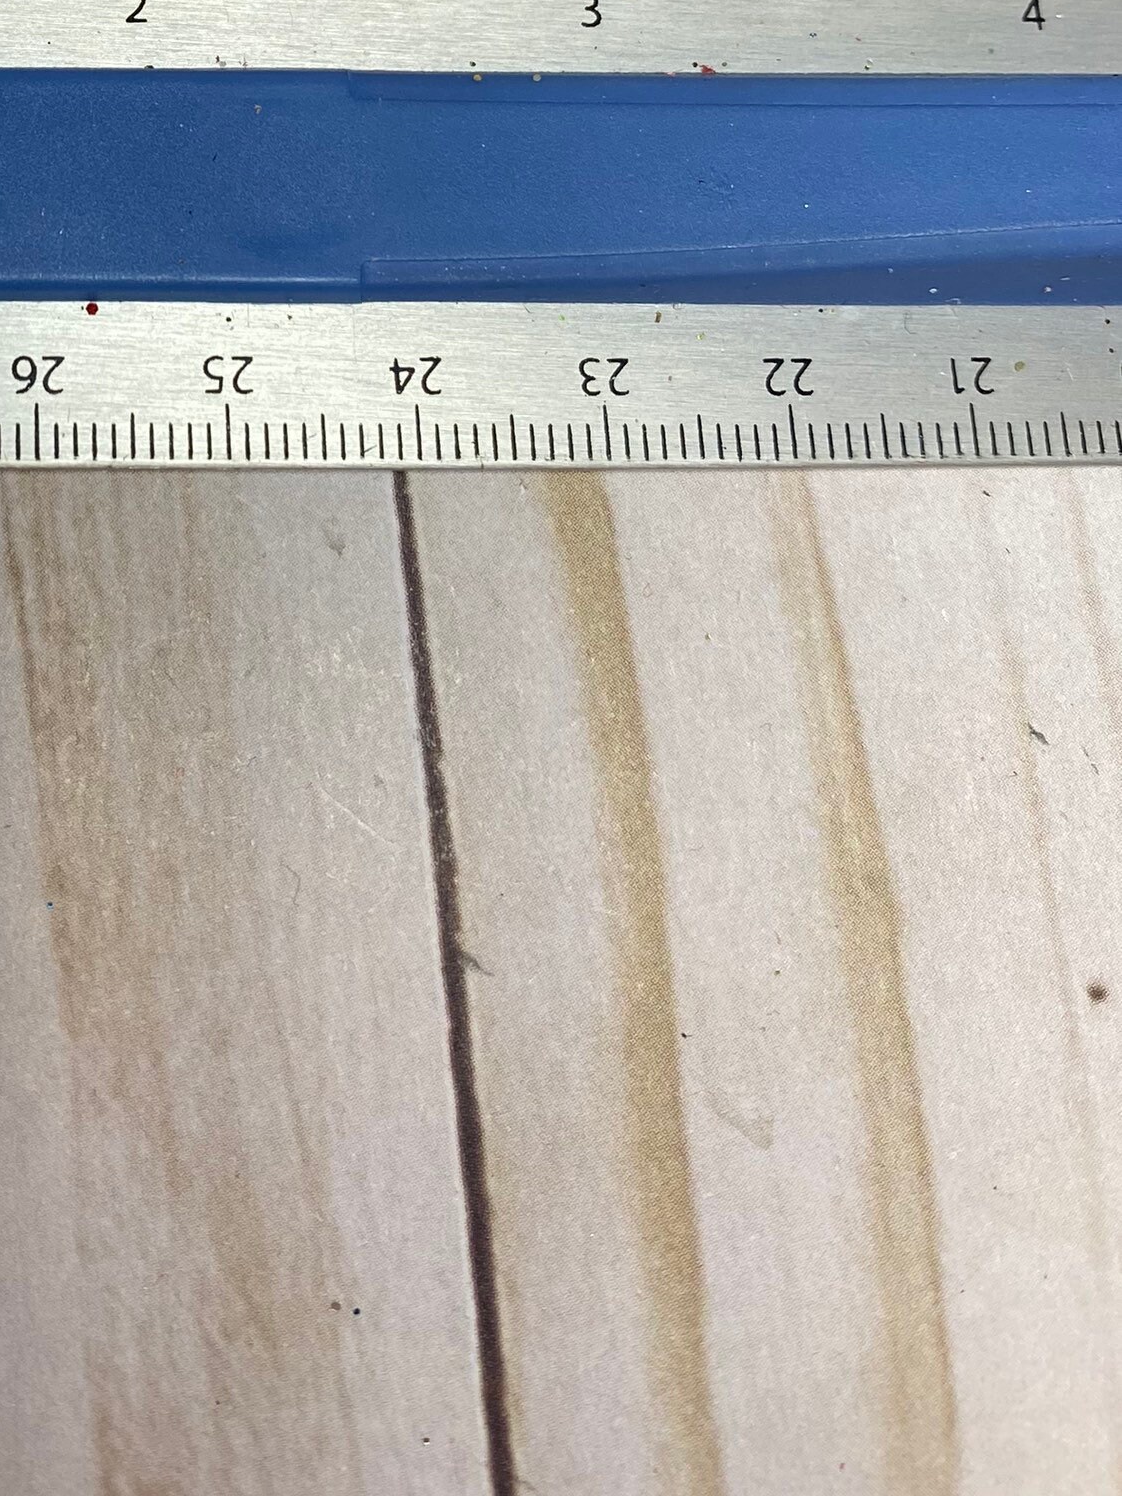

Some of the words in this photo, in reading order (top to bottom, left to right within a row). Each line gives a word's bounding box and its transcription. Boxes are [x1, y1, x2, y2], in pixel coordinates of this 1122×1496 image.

[11, 355, 66, 396] 26
[202, 354, 254, 395] 25
[388, 355, 443, 396] 24
[578, 357, 630, 397] 23
[762, 357, 815, 397] 22
[950, 356, 995, 395] 21
